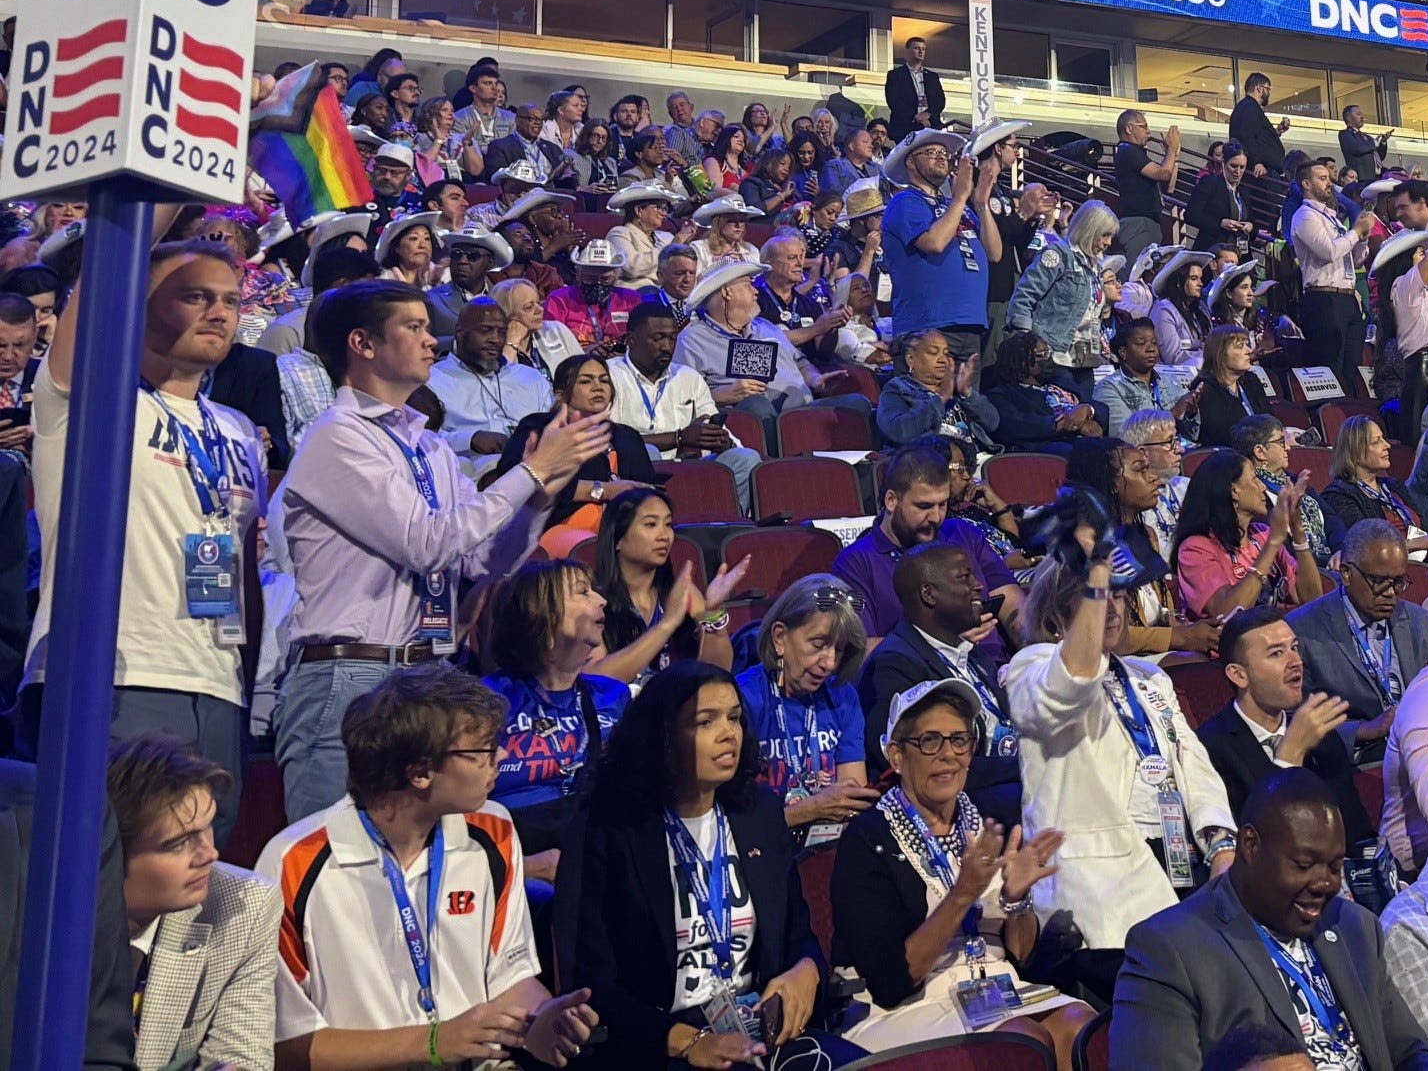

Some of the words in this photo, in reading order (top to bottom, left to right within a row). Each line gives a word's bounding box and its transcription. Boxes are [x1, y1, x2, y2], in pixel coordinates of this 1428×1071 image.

[975, 6, 990, 120] KENTUCKY
[141, 14, 176, 159] DNC
[13, 40, 50, 179] DNC
[46, 130, 117, 172] 2024
[172, 141, 235, 183] 2024
[1305, 383, 1337, 392] RESERVED
[500, 761, 522, 772] and
[402, 907, 415, 932] DNC
